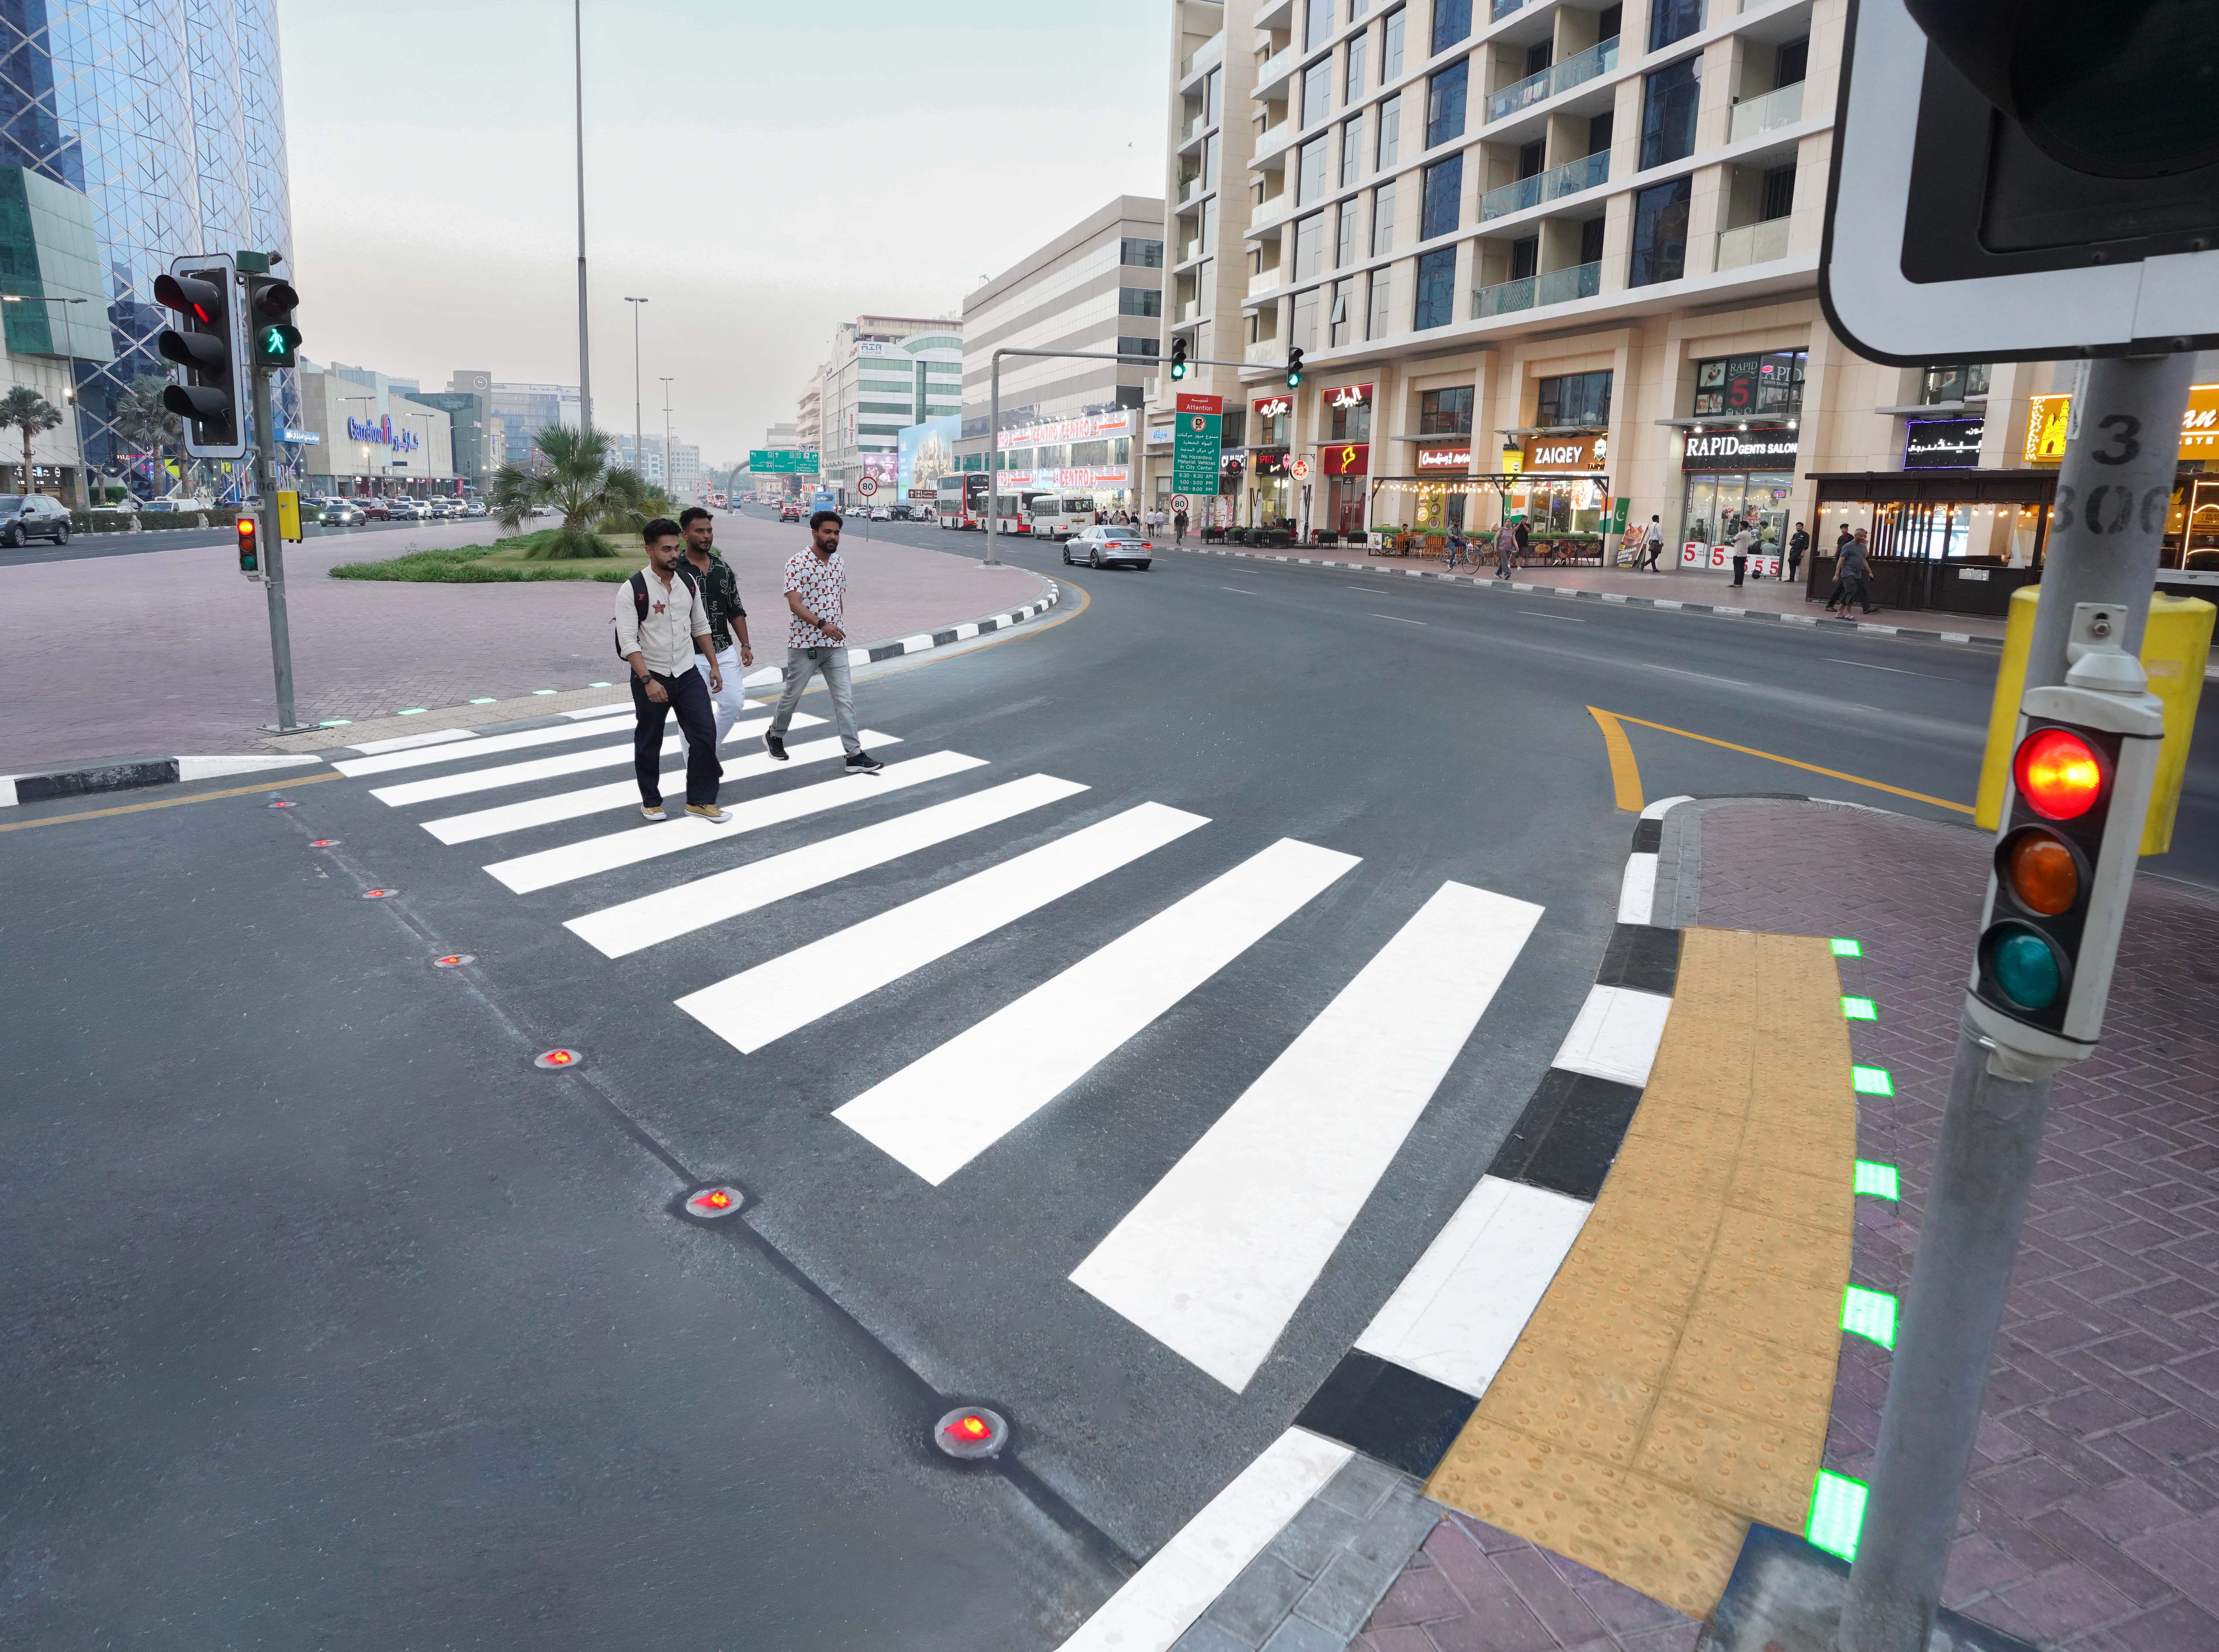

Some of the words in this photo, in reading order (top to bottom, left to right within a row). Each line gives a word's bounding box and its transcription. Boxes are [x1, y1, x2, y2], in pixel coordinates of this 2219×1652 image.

[1730, 361, 1758, 372] RAPID
[1762, 366, 1802, 382] APID
[1730, 378, 1749, 406] 5
[1033, 425, 1058, 443] CENTRO
[1061, 419, 1090, 439] CENTRO
[1686, 436, 1739, 456] RAPID
[1738, 443, 1766, 455] GENTS
[1767, 442, 1798, 454] SALON
[2093, 414, 2141, 466] 3
[1259, 455, 1275, 464] SPRITZ
[1535, 446, 1583, 464] ZAIQEY
[1060, 469, 1090, 486] CENTRO
[1618, 547, 1637, 555] HYDERABADI
[1684, 544, 1696, 561] 5
[1712, 548, 1724, 566] 5
[1754, 560, 1763, 572] 5
[1769, 561, 1779, 574] 5
